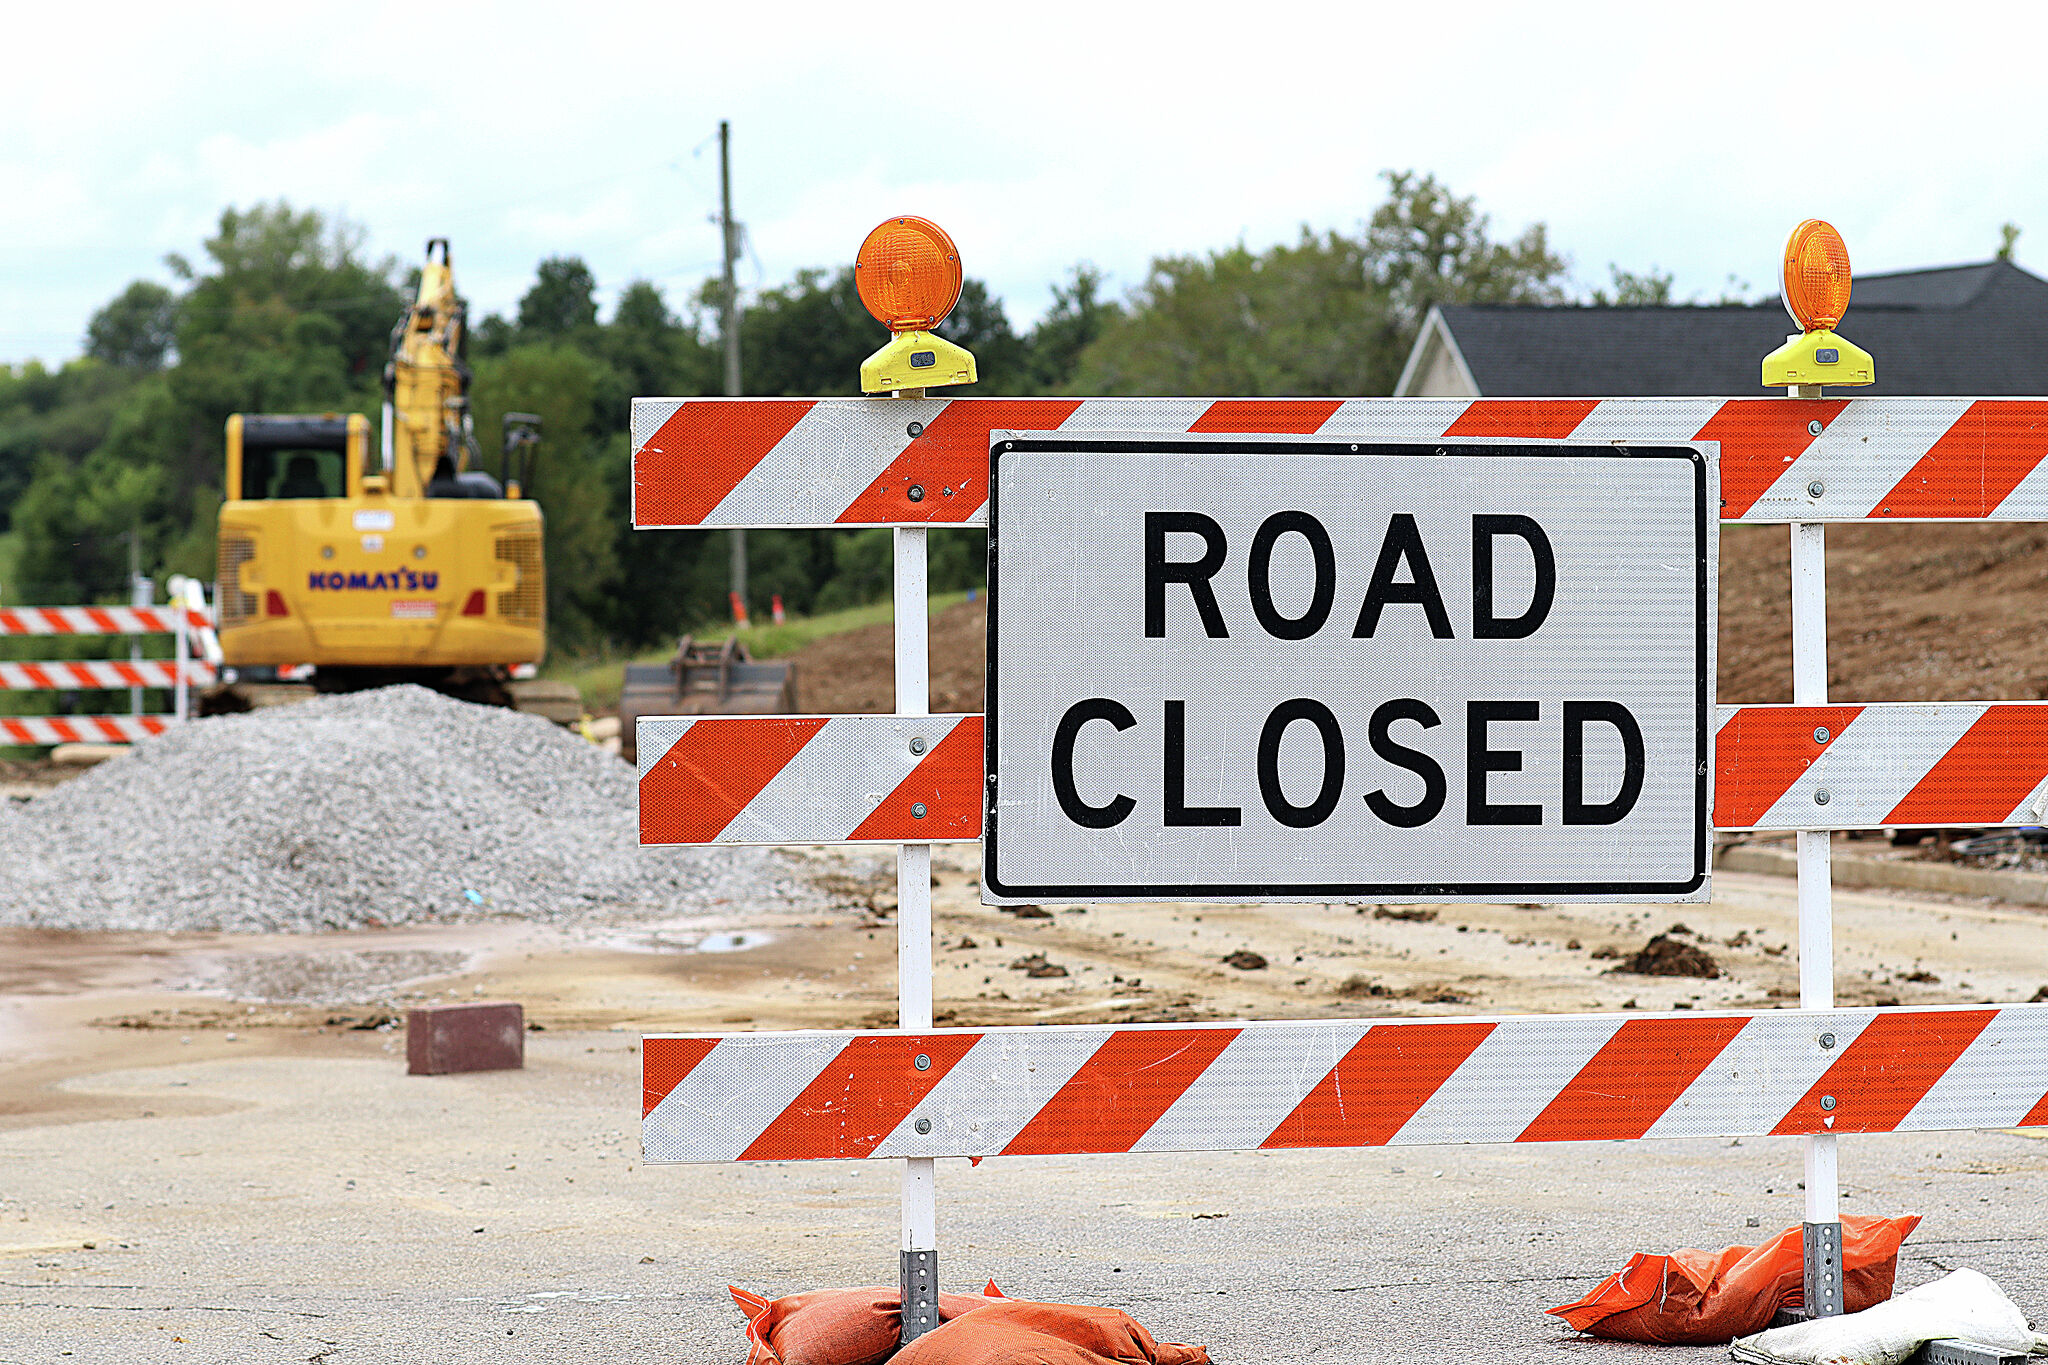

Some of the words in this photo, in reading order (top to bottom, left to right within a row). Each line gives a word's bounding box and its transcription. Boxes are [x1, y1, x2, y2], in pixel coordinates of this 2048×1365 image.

[309, 566, 439, 591] KOMATSU
[1145, 511, 1556, 640] ROAD
[1051, 698, 1645, 829] CLOSED
